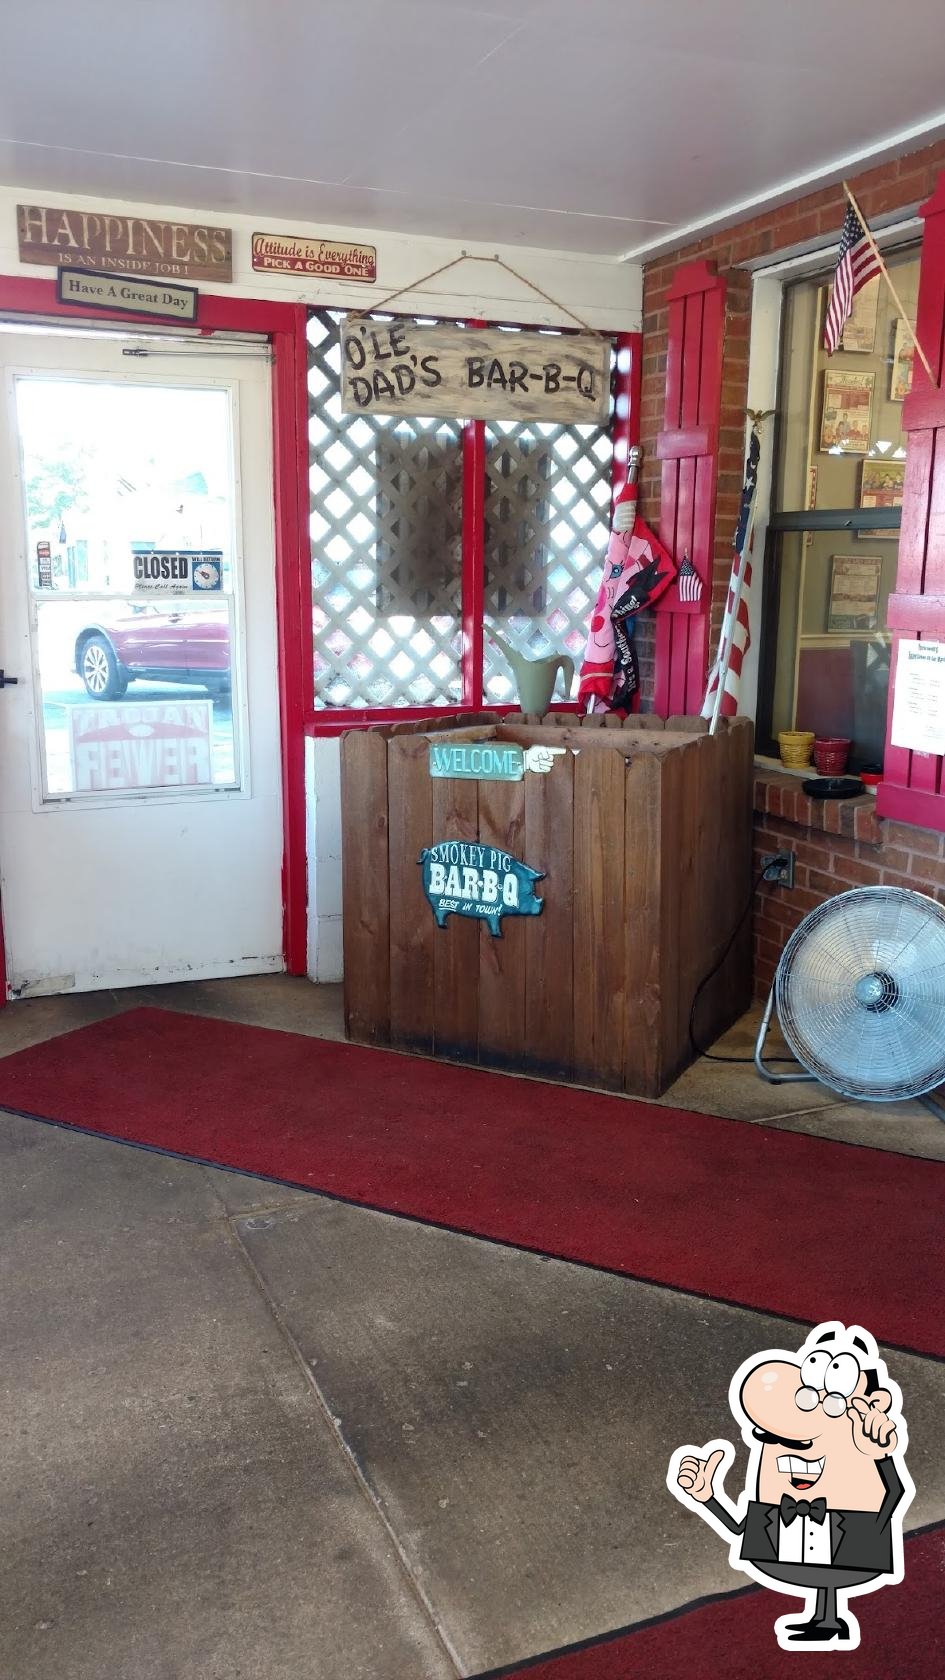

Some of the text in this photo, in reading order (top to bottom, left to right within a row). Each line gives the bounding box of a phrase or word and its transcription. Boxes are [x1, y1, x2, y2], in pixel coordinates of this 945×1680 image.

[22, 206, 226, 263] HAPPINESS
[58, 252, 72, 264] IS
[77, 255, 97, 266] AN
[101, 257, 151, 271] INSIDE
[254, 238, 375, 267] Attitude is Everything
[264, 257, 370, 277] PICK A GOOD ONE
[68, 279, 188, 310] Have A Great Day
[344, 325, 411, 370] O'LE
[349, 355, 597, 408] DAD'S BAR-B-Q
[133, 556, 188, 579] CLOSED
[433, 747, 518, 775] WELCOME
[431, 844, 512, 873] SMOKEY PIG
[438, 899, 503, 917] BEST IN TOWN!
